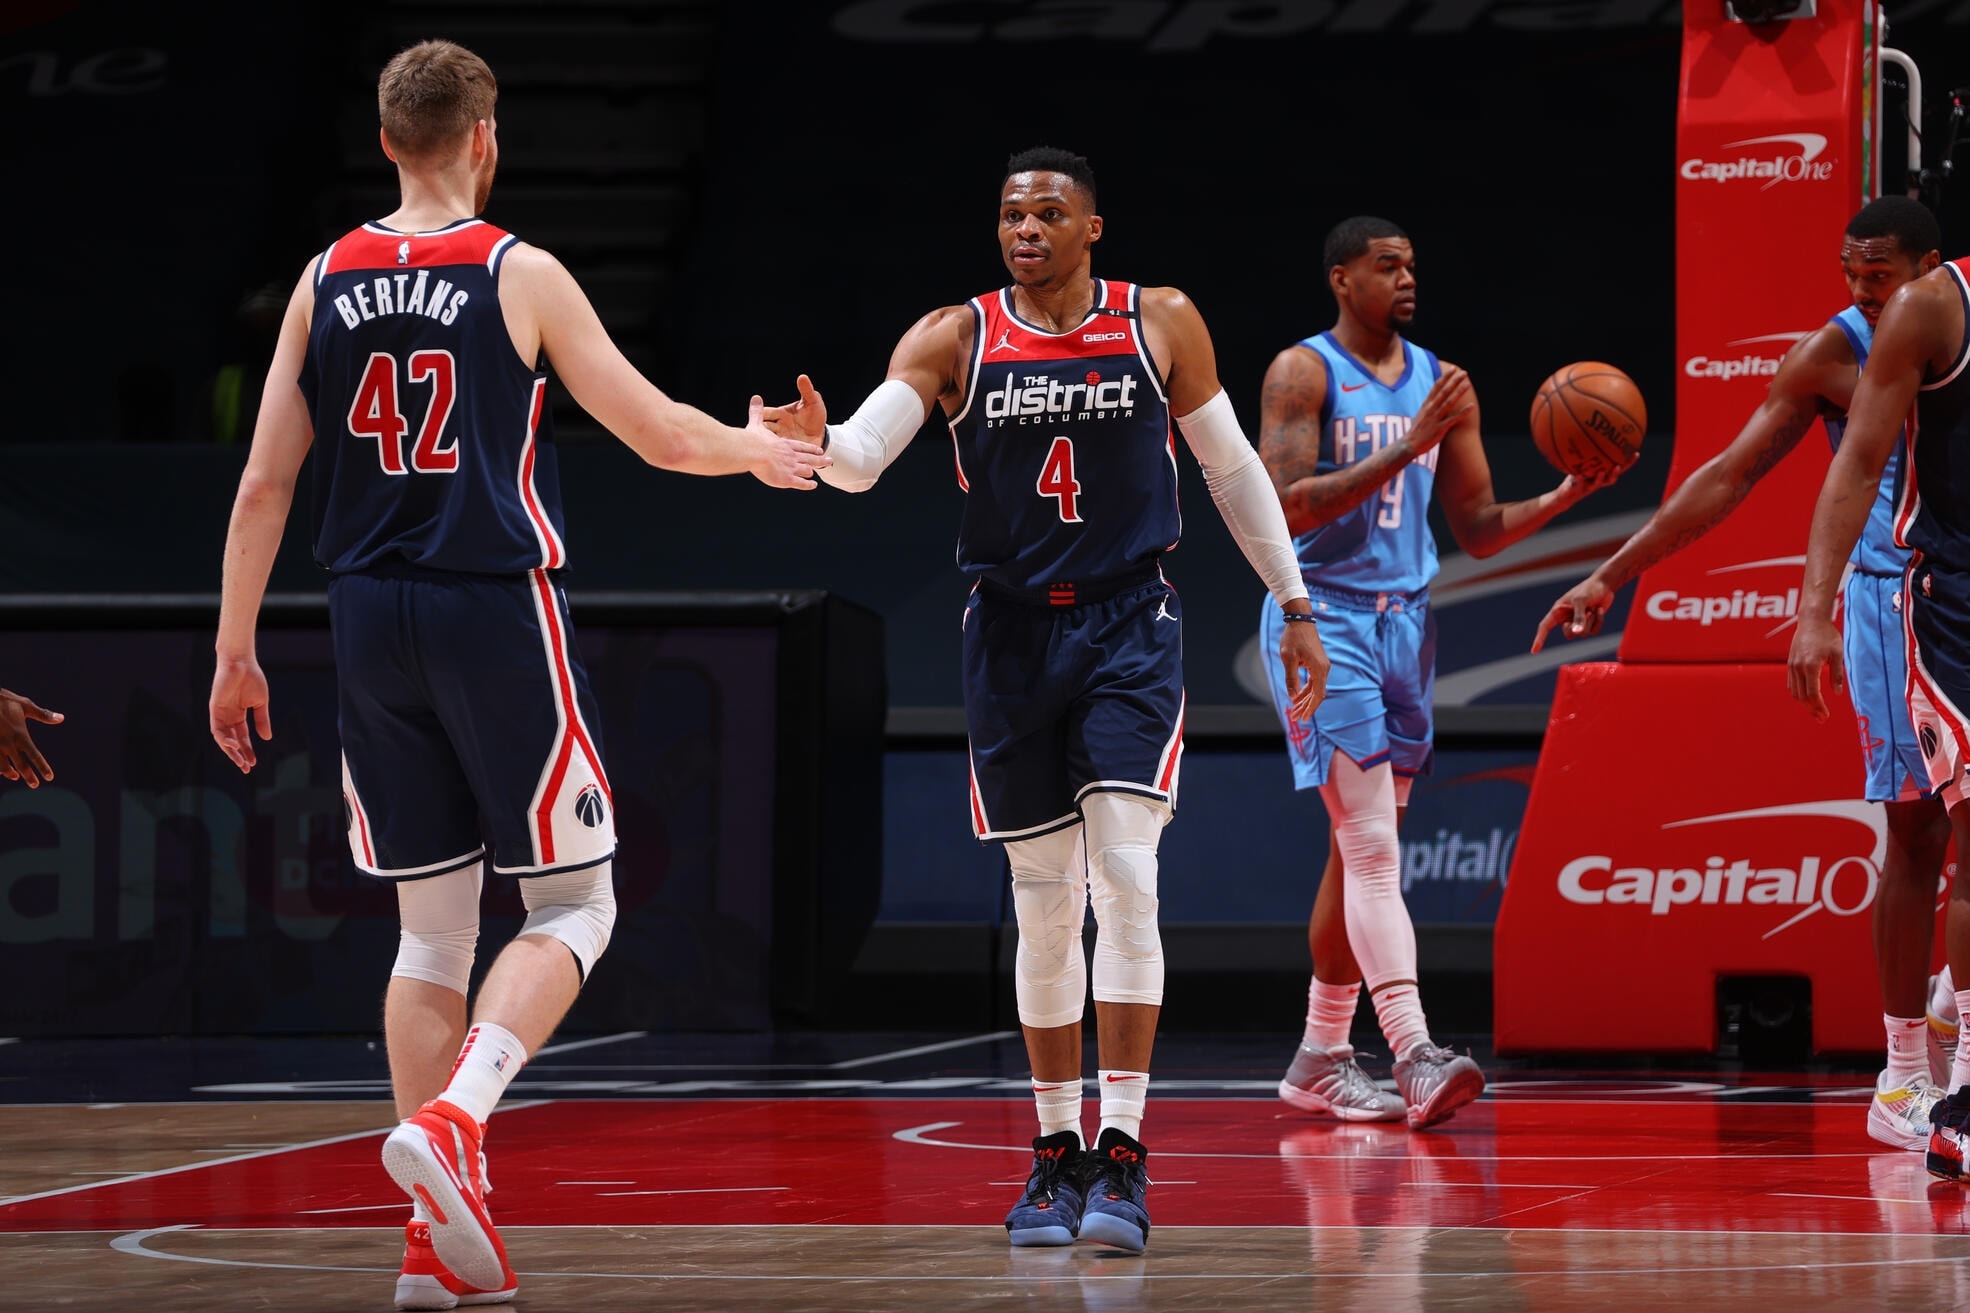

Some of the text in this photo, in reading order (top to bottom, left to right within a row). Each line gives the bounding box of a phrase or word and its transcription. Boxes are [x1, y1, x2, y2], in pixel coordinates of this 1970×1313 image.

[1082, 331, 1127, 343] GEICO
[985, 371, 1138, 420] district
[1023, 375, 1049, 387] THE
[347, 349, 460, 476] 42
[987, 409, 1134, 429] OF COLUMBIA
[1036, 435, 1085, 524] 4
[1376, 468, 1406, 529] 9
[1645, 586, 1800, 628] Capital
[1556, 854, 1822, 916] Capital
[413, 1227, 431, 1241] 42
